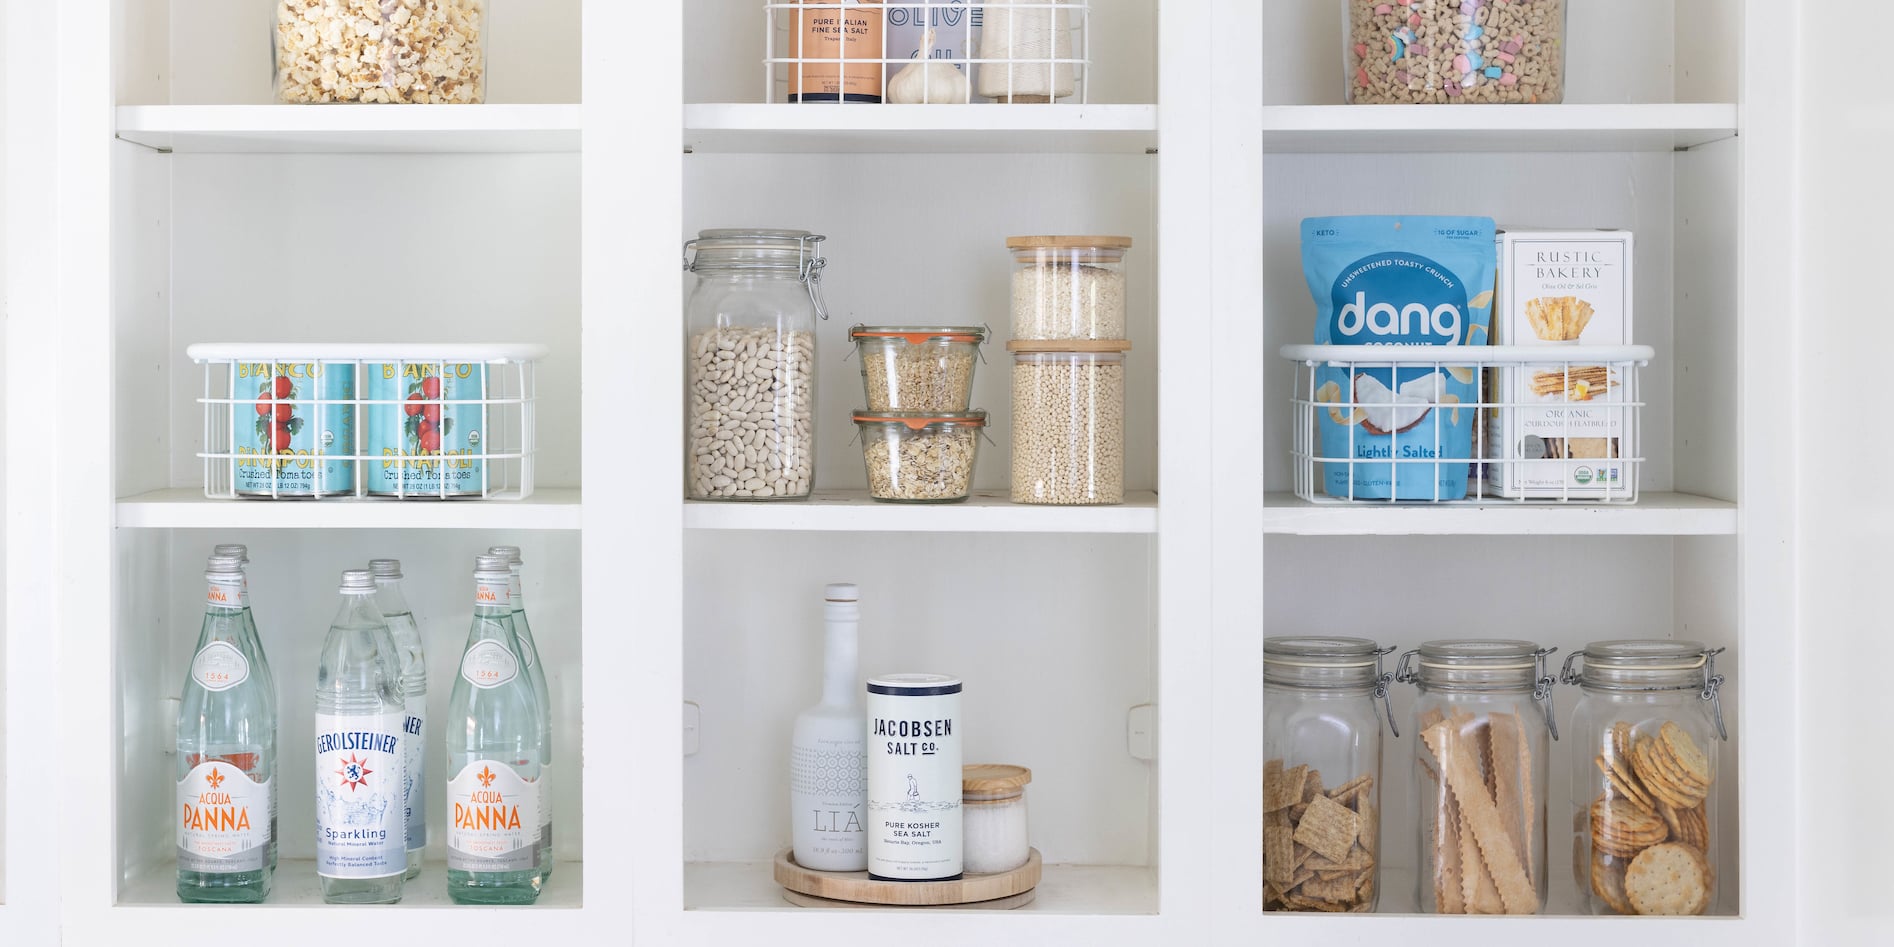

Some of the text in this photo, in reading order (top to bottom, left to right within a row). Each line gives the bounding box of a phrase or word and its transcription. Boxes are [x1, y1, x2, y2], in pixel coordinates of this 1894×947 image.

[837, 18, 868, 26] IALIAN
[889, 5, 984, 27] OLIVE
[851, 27, 869, 35] SALT
[1537, 251, 1603, 263] RUSTIC
[1341, 259, 1455, 289] UNSWEETENED TOASTY CRUNCH
[1537, 267, 1602, 279] BAKERY
[1338, 291, 1461, 346] dang
[382, 363, 473, 379] BANCO
[239, 468, 271, 479] Crushed
[383, 470, 421, 480] Cruhed
[207, 592, 227, 602] ANNA
[476, 592, 497, 601] NNA
[874, 718, 952, 737] JACOBSEN
[317, 732, 398, 754] GEROLSTEINER
[887, 741, 939, 755] SALT CO.
[199, 792, 232, 805] ACQUA
[470, 790, 503, 804] ACQUA
[183, 803, 251, 832] PANNA
[455, 801, 521, 831] PANNA
[813, 803, 864, 833] LIÁ
[885, 821, 940, 830] PURE KOSHER
[326, 827, 387, 840] Sparkling
[893, 830, 931, 838] SEA SALT
